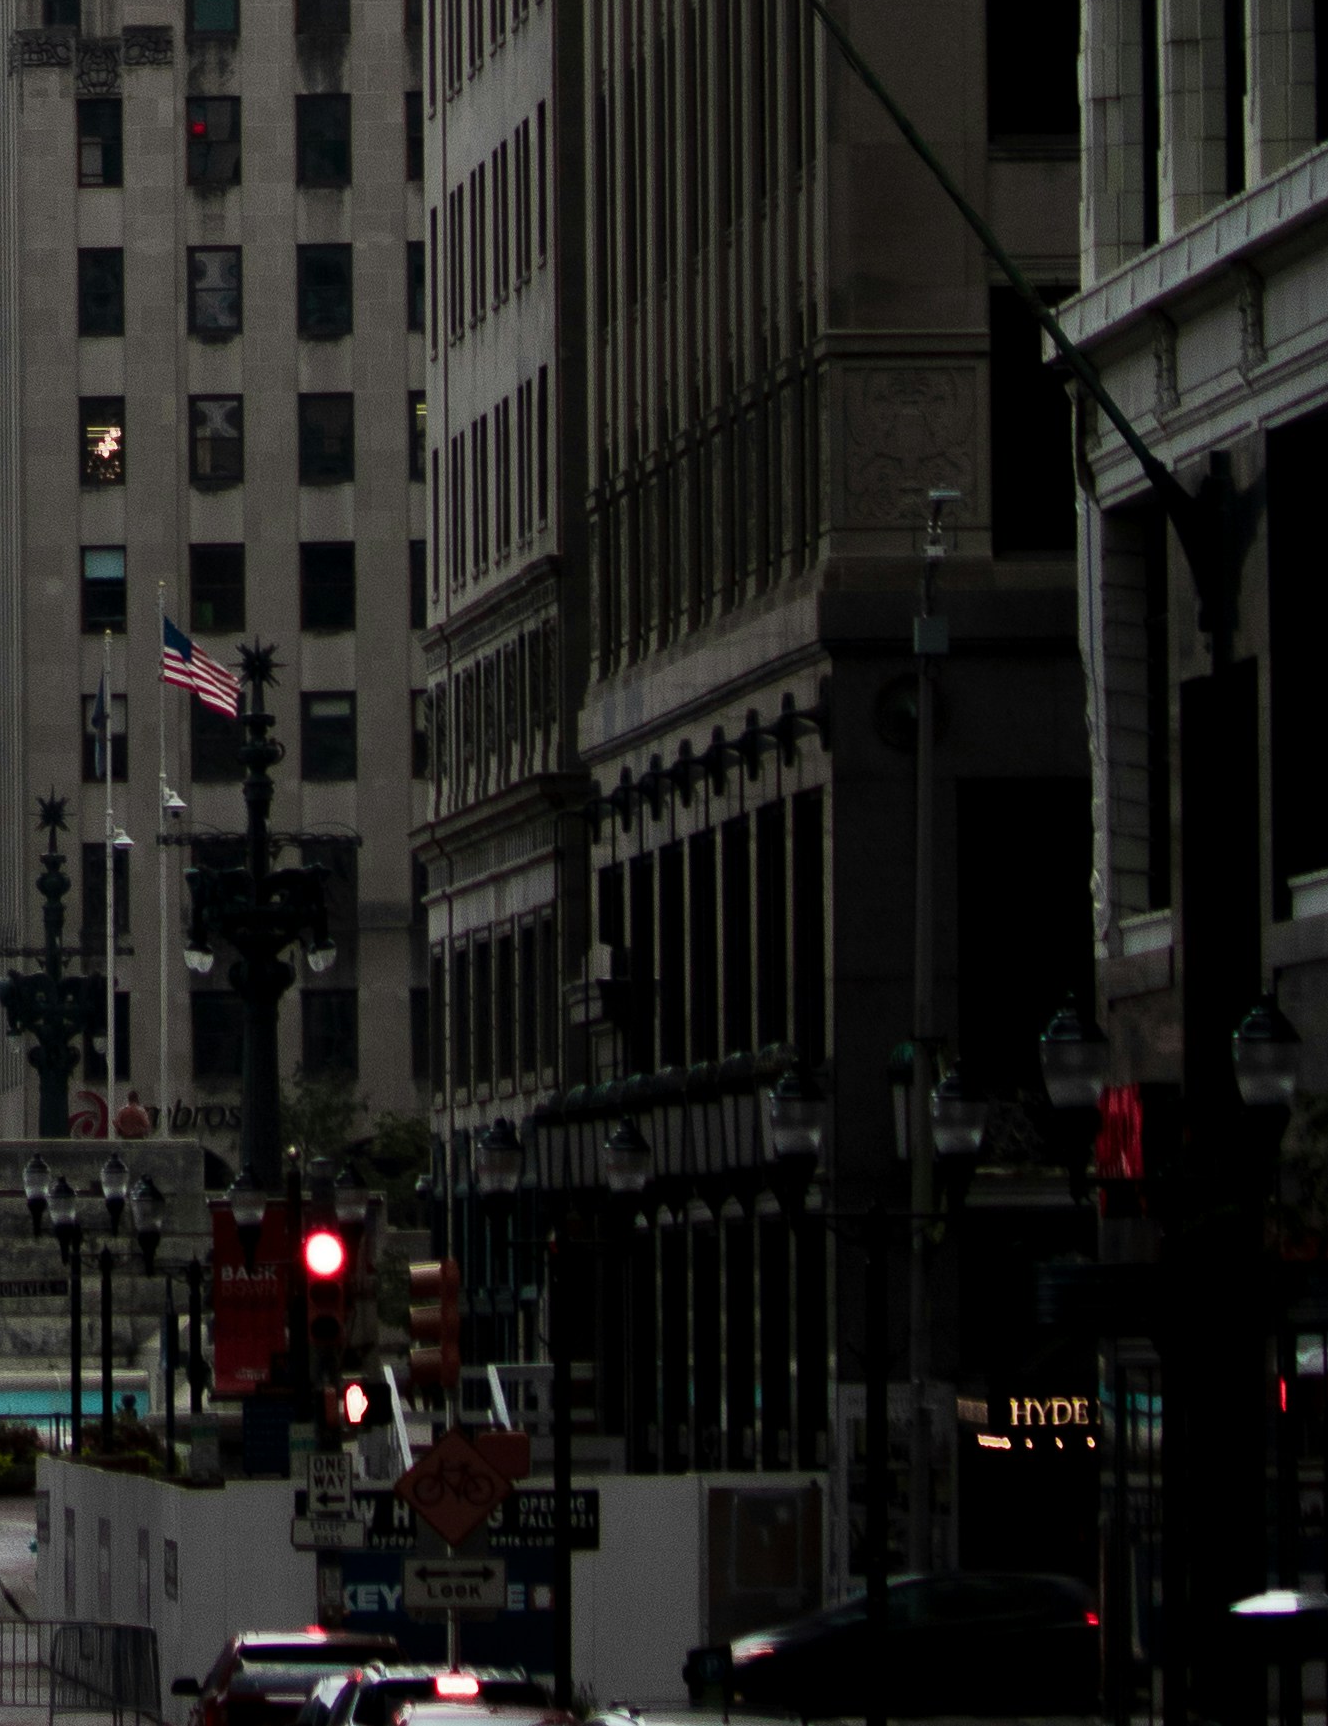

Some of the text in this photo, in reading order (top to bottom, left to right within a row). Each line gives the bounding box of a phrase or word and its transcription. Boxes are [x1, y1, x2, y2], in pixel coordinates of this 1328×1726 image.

[1009, 1395, 1090, 1426] HYDE
[313, 1457, 347, 1473] ONE
[313, 1474, 346, 1488] WAY
[518, 1512, 556, 1529] FALL
[426, 1584, 483, 1600] LOOK
